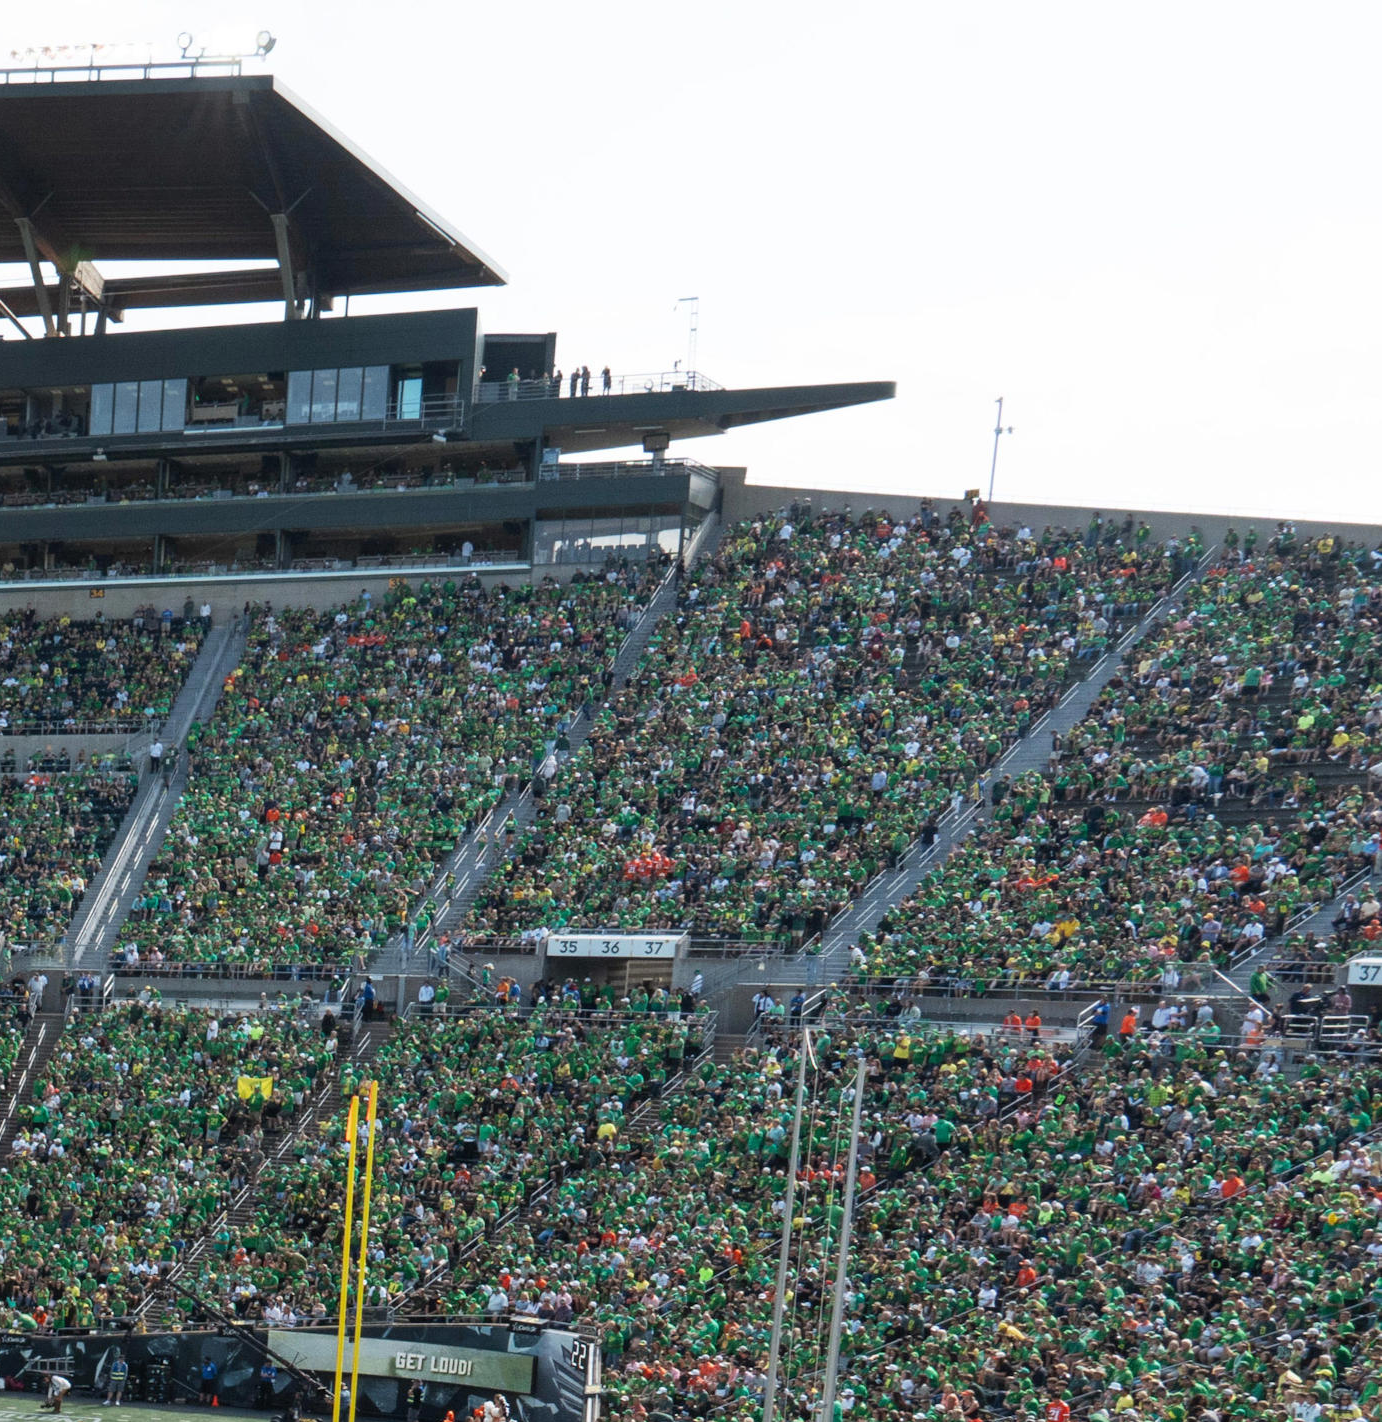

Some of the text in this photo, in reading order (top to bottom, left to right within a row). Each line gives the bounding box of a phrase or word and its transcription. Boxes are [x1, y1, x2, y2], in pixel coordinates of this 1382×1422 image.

[559, 941, 663, 954] 35 36 37
[1358, 965, 1382, 982] 37
[395, 1351, 473, 1377] GET LOUD!
[570, 1340, 587, 1370] 22
